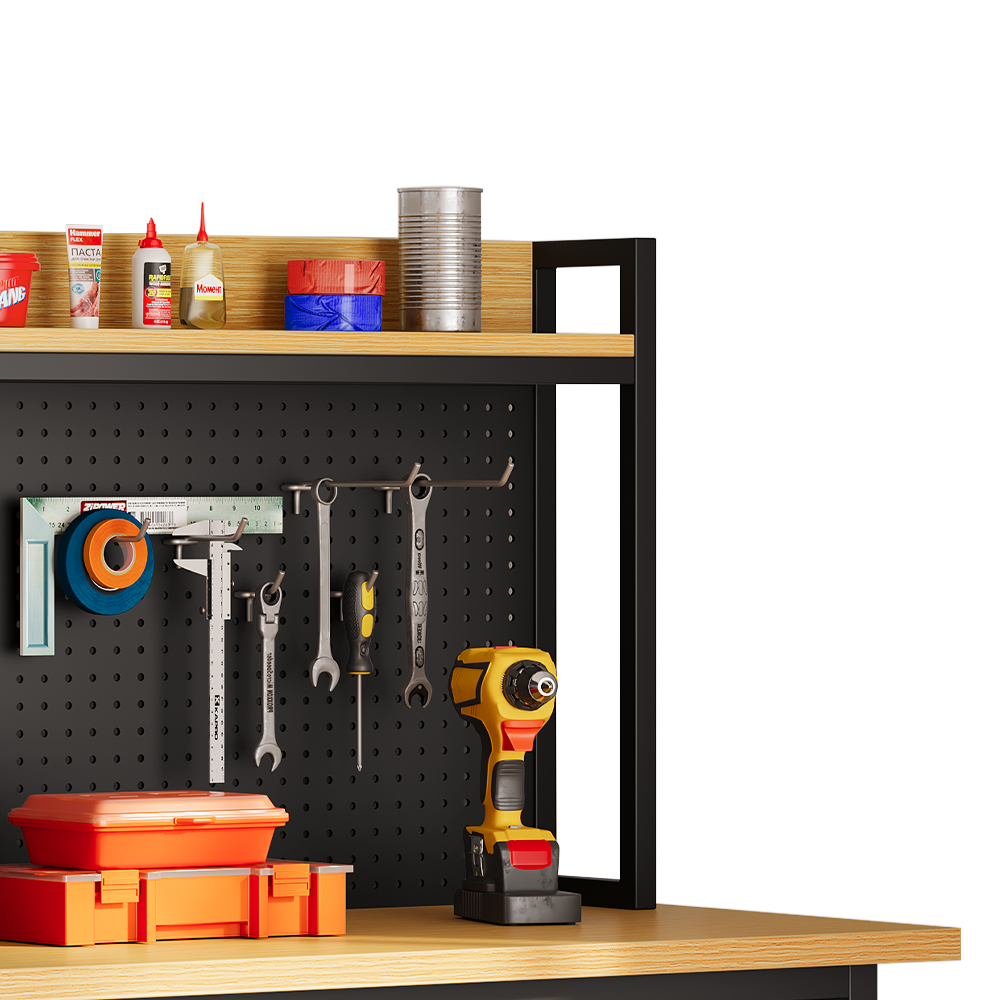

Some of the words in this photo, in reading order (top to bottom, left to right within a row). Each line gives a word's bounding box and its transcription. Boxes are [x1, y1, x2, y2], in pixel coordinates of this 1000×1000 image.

[70, 229, 101, 238] Hammer
[72, 248, 102, 257] ПАСТА
[196, 283, 222, 294] Момент
